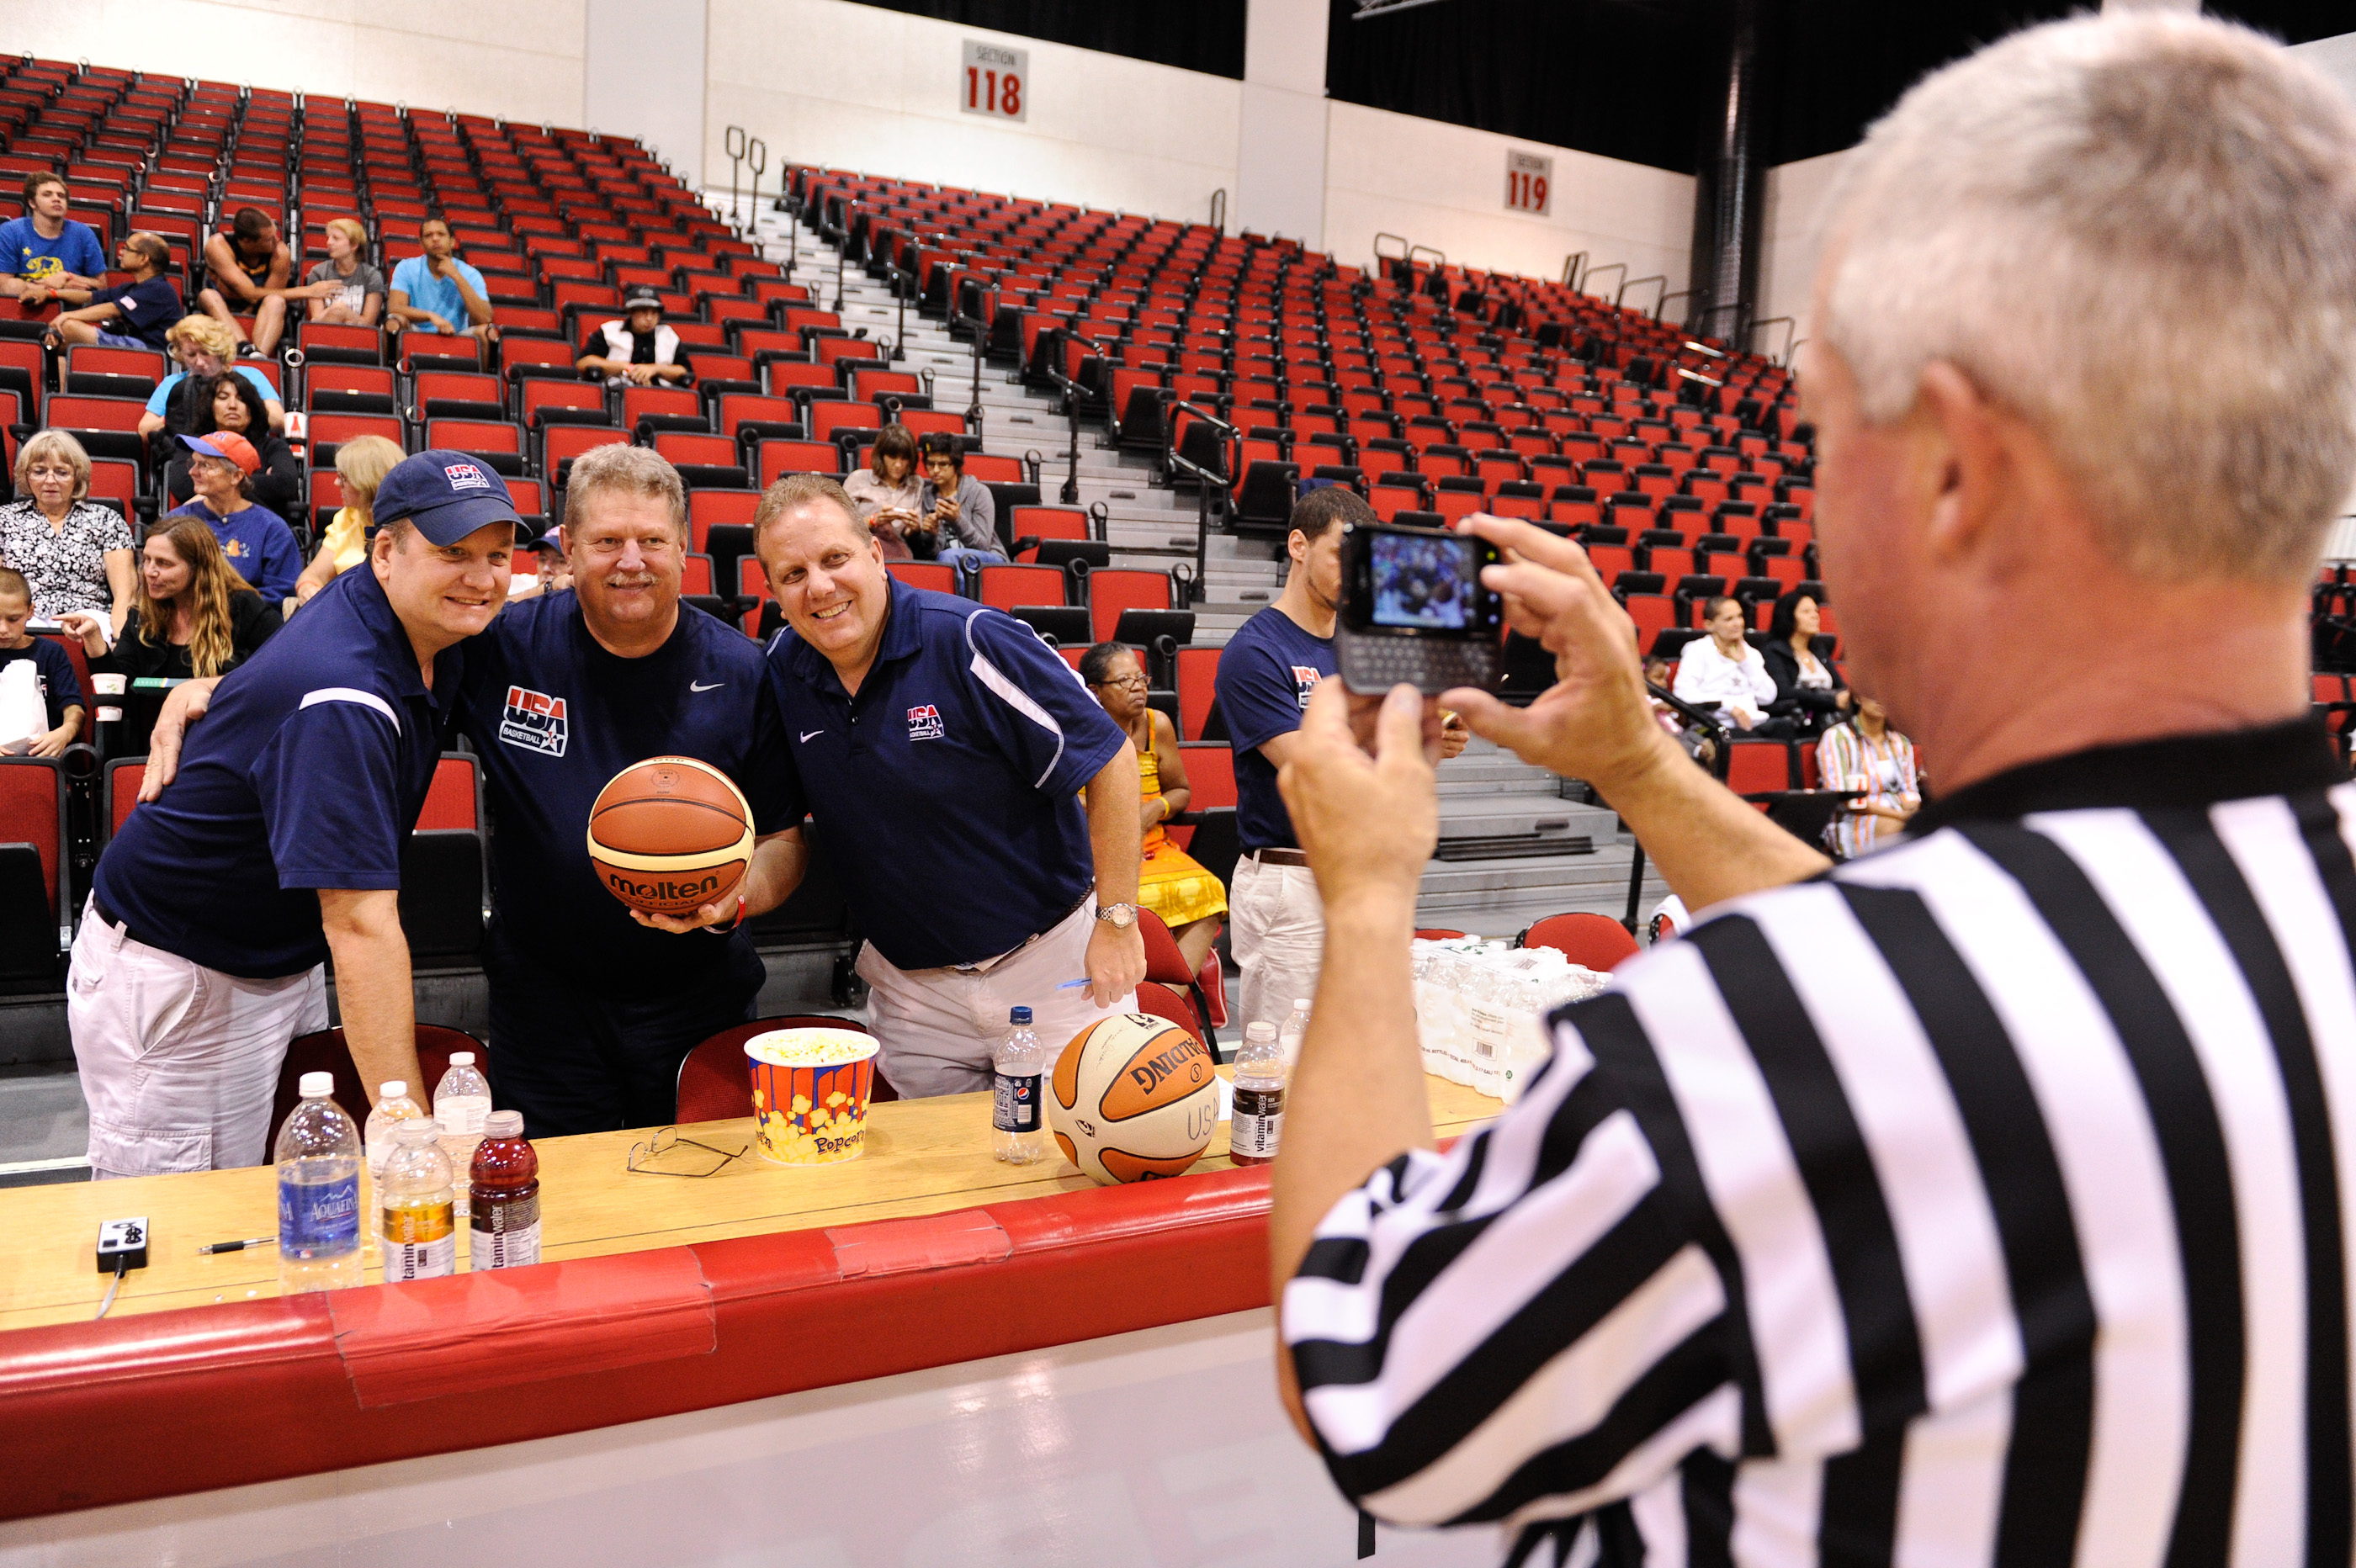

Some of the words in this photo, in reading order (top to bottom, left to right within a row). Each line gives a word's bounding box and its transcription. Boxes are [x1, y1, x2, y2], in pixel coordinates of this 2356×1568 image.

[967, 66, 1021, 115] 118
[1510, 170, 1547, 210] 119
[444, 464, 486, 480] USA
[502, 727, 540, 745] BASKETBALL
[504, 686, 567, 740] USA
[908, 705, 942, 729] USA
[610, 873, 718, 900] molten
[1130, 1037, 1207, 1095] PALDING
[1255, 1093, 1267, 1152] vitaminwater
[401, 1215, 415, 1279] taminwater
[491, 1205, 505, 1269] taminwater
